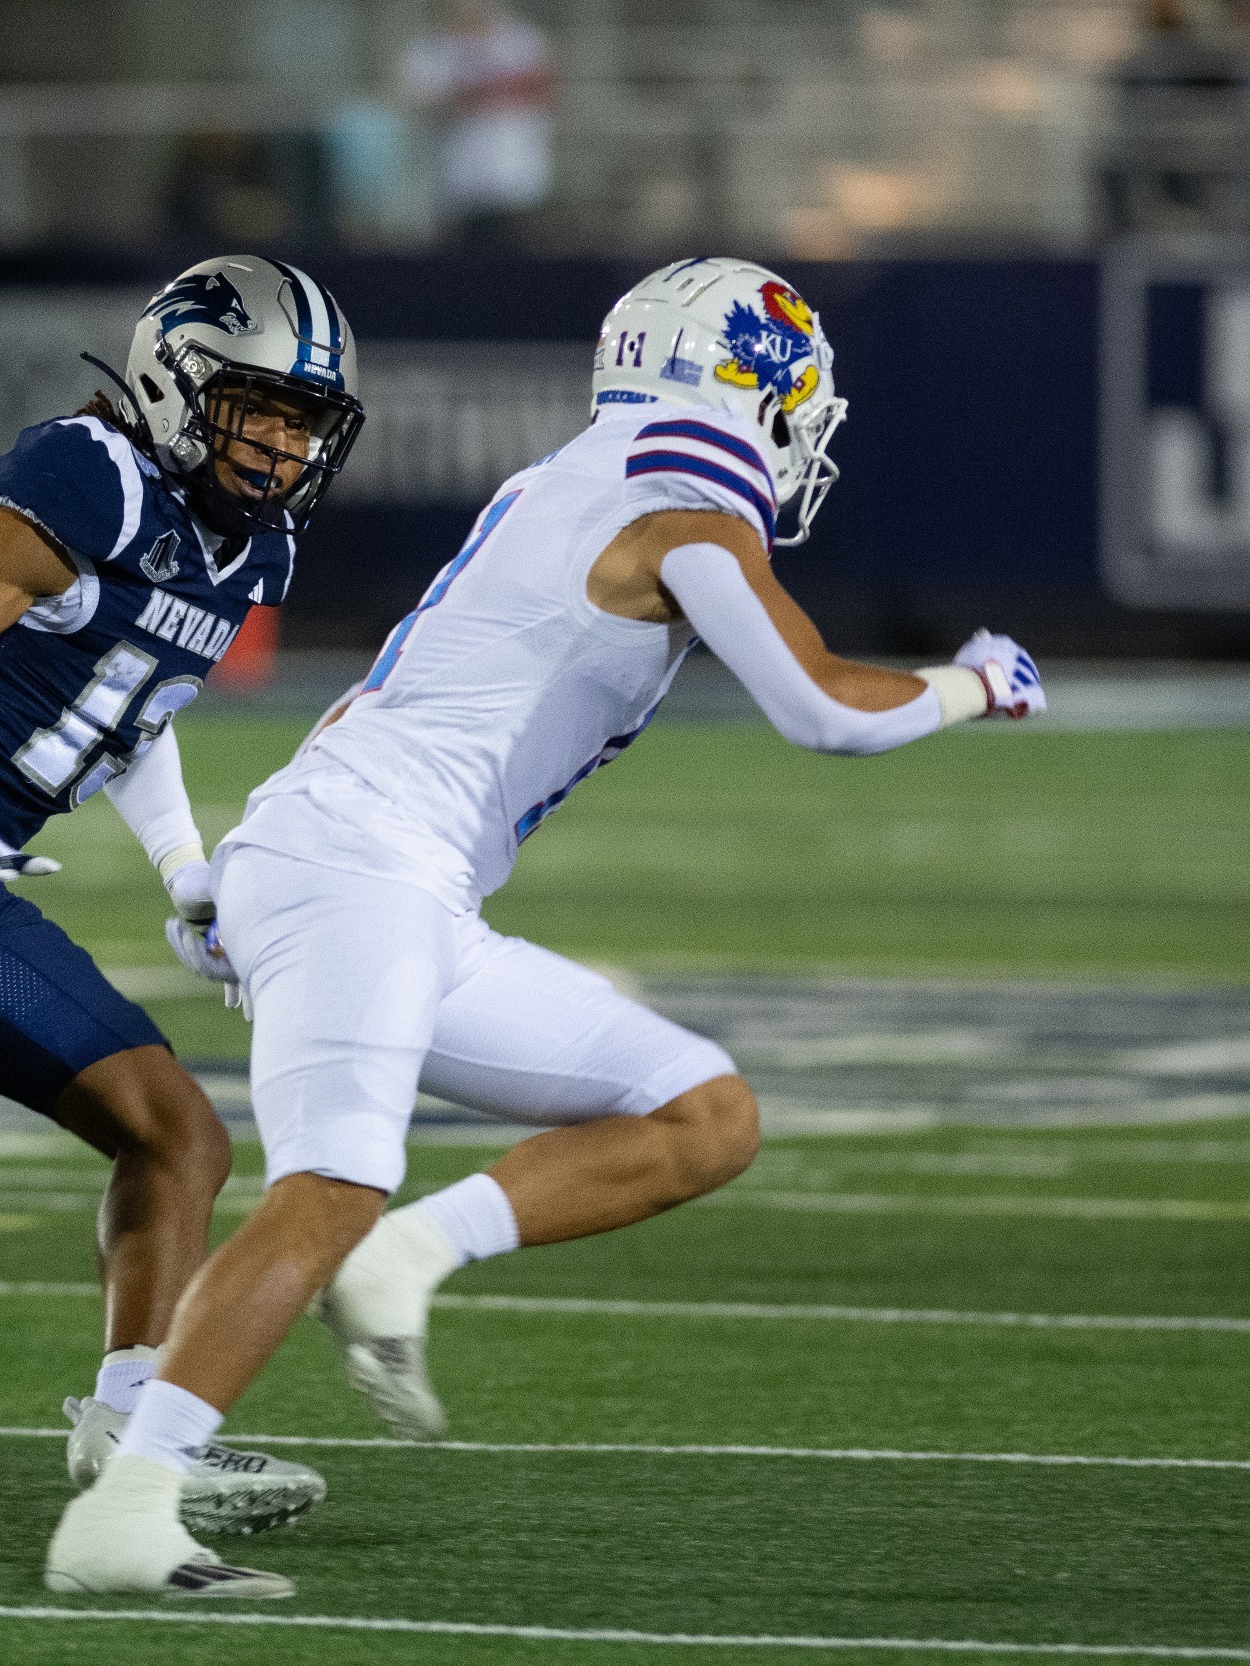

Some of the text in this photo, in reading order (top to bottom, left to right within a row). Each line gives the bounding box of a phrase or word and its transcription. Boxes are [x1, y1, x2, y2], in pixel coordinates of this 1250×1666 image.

[616, 331, 646, 368] 11
[758, 329, 794, 364] KU
[304, 361, 337, 381] NEVADA
